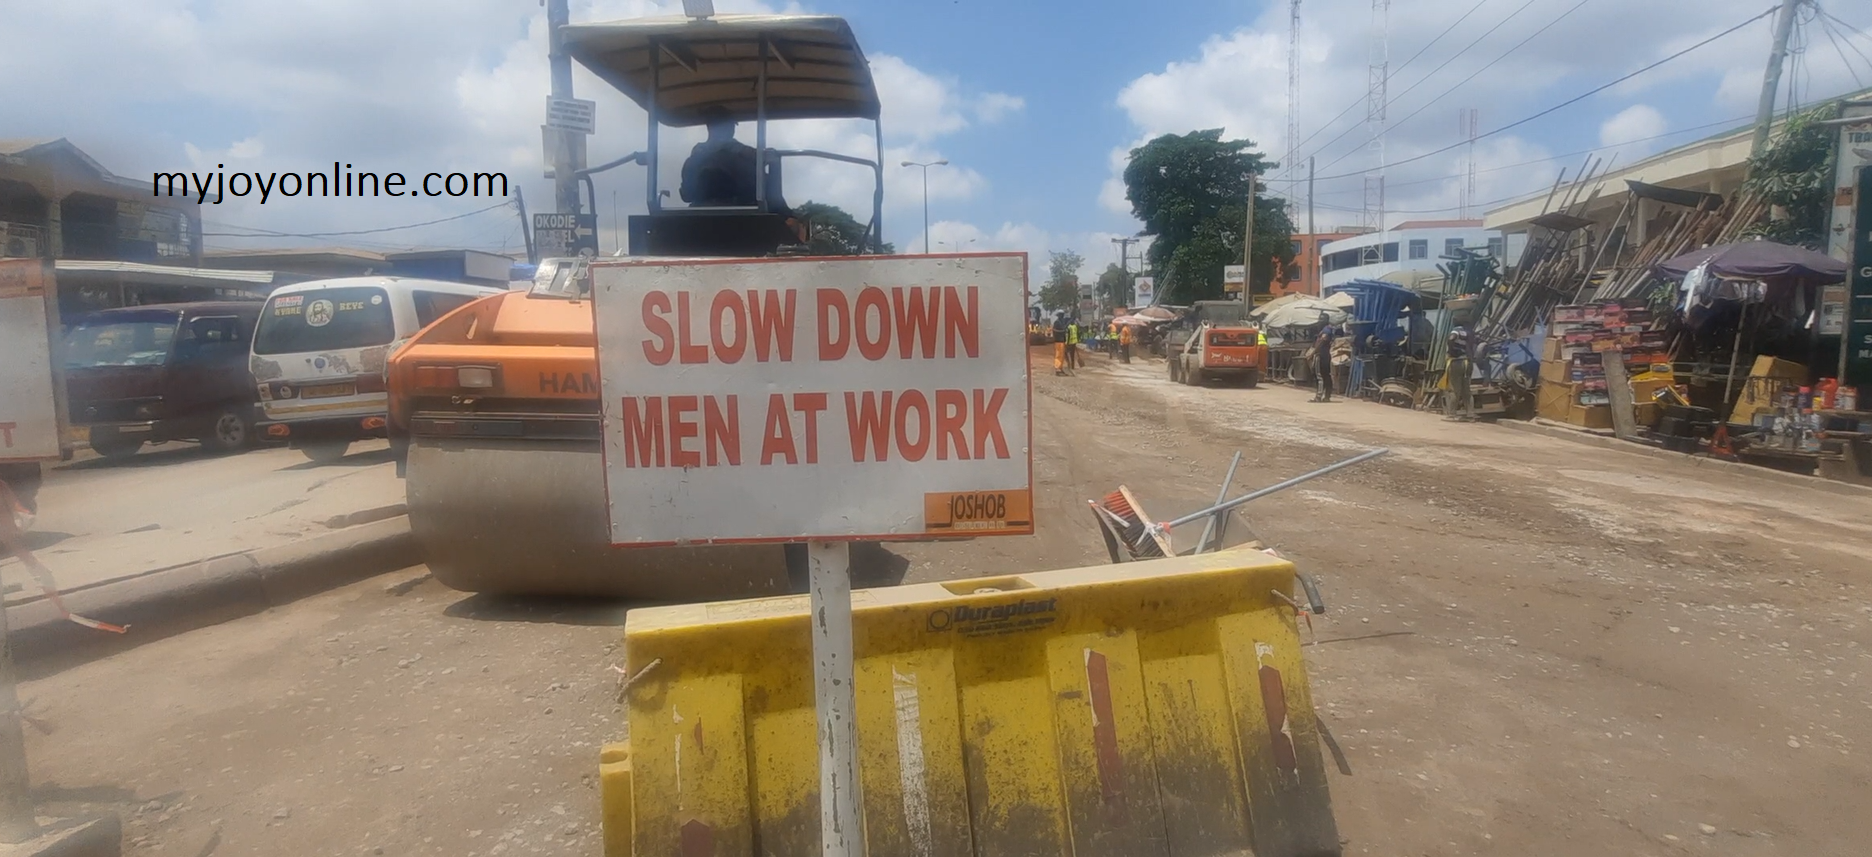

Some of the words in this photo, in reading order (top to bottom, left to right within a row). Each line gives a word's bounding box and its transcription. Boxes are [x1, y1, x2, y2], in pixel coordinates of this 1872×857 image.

[535, 214, 576, 229] OKODIE
[641, 288, 797, 366] SLOW
[816, 286, 979, 361] DOWN
[621, 394, 741, 468] MEN
[760, 391, 828, 466] AT
[844, 388, 1010, 463] WORK
[949, 493, 1006, 522] JOSHOB
[953, 598, 1057, 622] Duraplast
